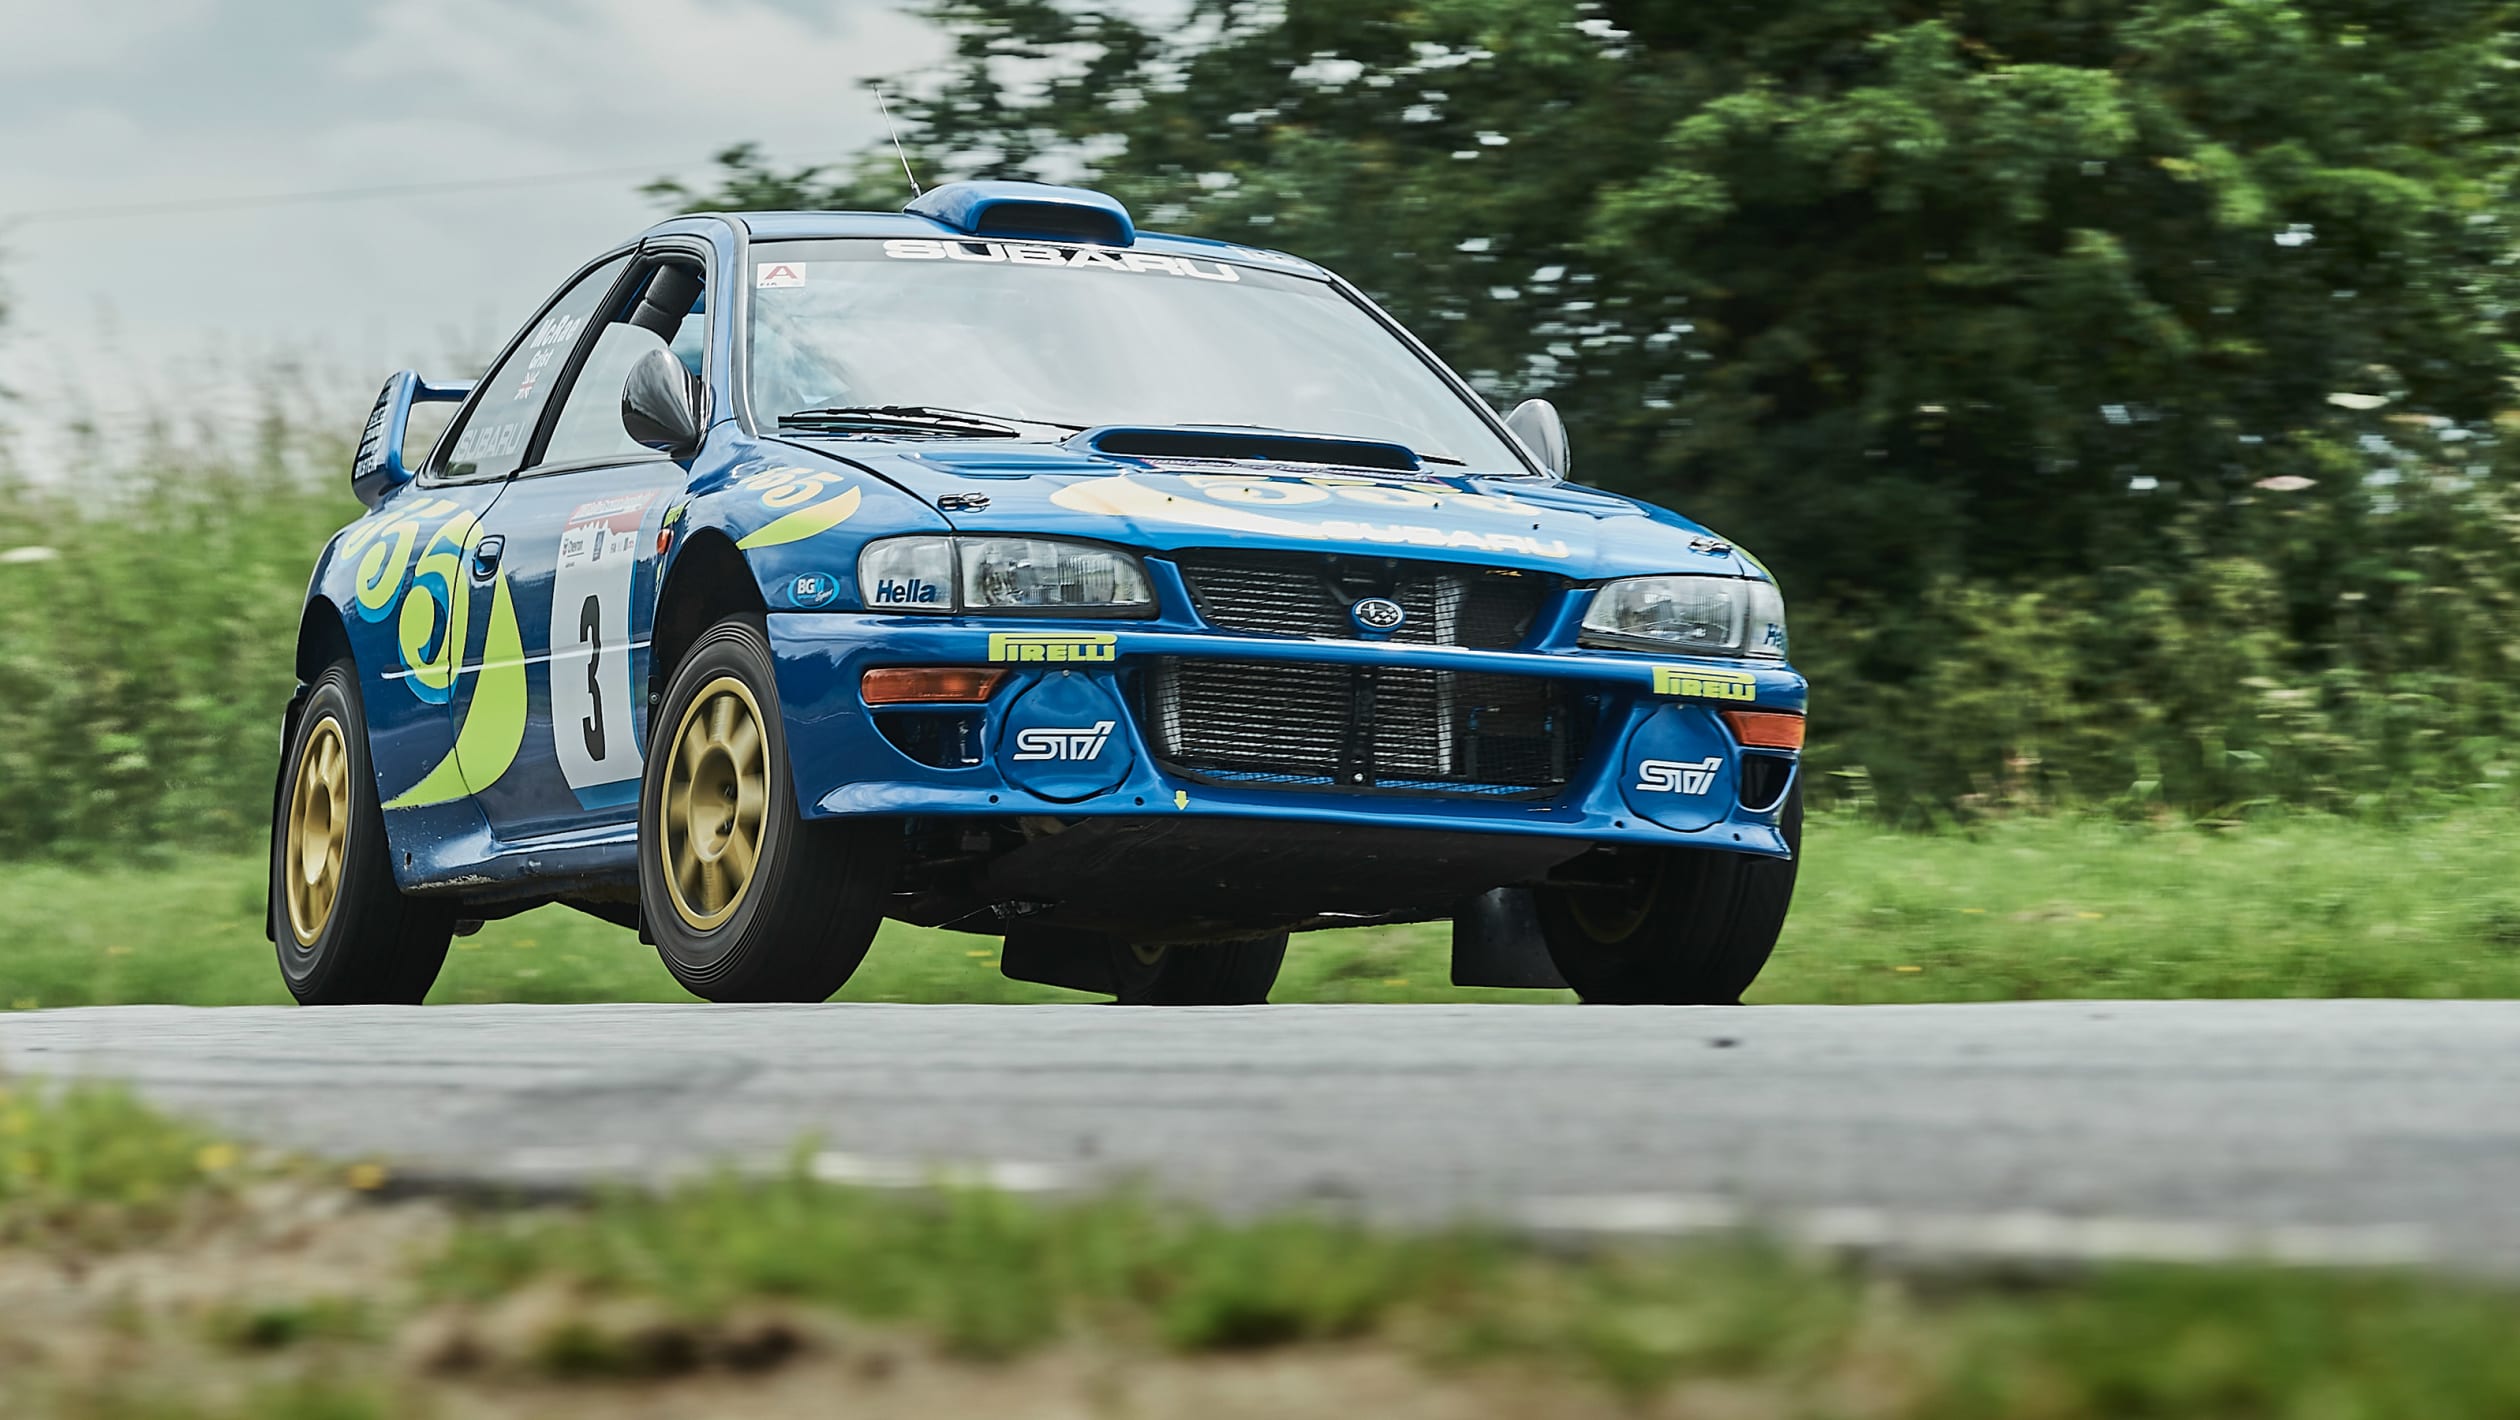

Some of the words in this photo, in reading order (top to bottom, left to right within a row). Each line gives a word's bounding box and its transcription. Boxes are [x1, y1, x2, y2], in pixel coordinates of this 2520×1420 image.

[764, 265, 798, 281] A
[883, 239, 1241, 283] SUBARU
[530, 314, 581, 349] McRae
[454, 421, 526, 462] SUBARU
[1320, 520, 1570, 559] SUBARU
[876, 579, 937, 603] Hella
[988, 632, 1118, 662] PIRELLI
[580, 594, 606, 762] 3
[1652, 666, 1757, 702] PIRELLI
